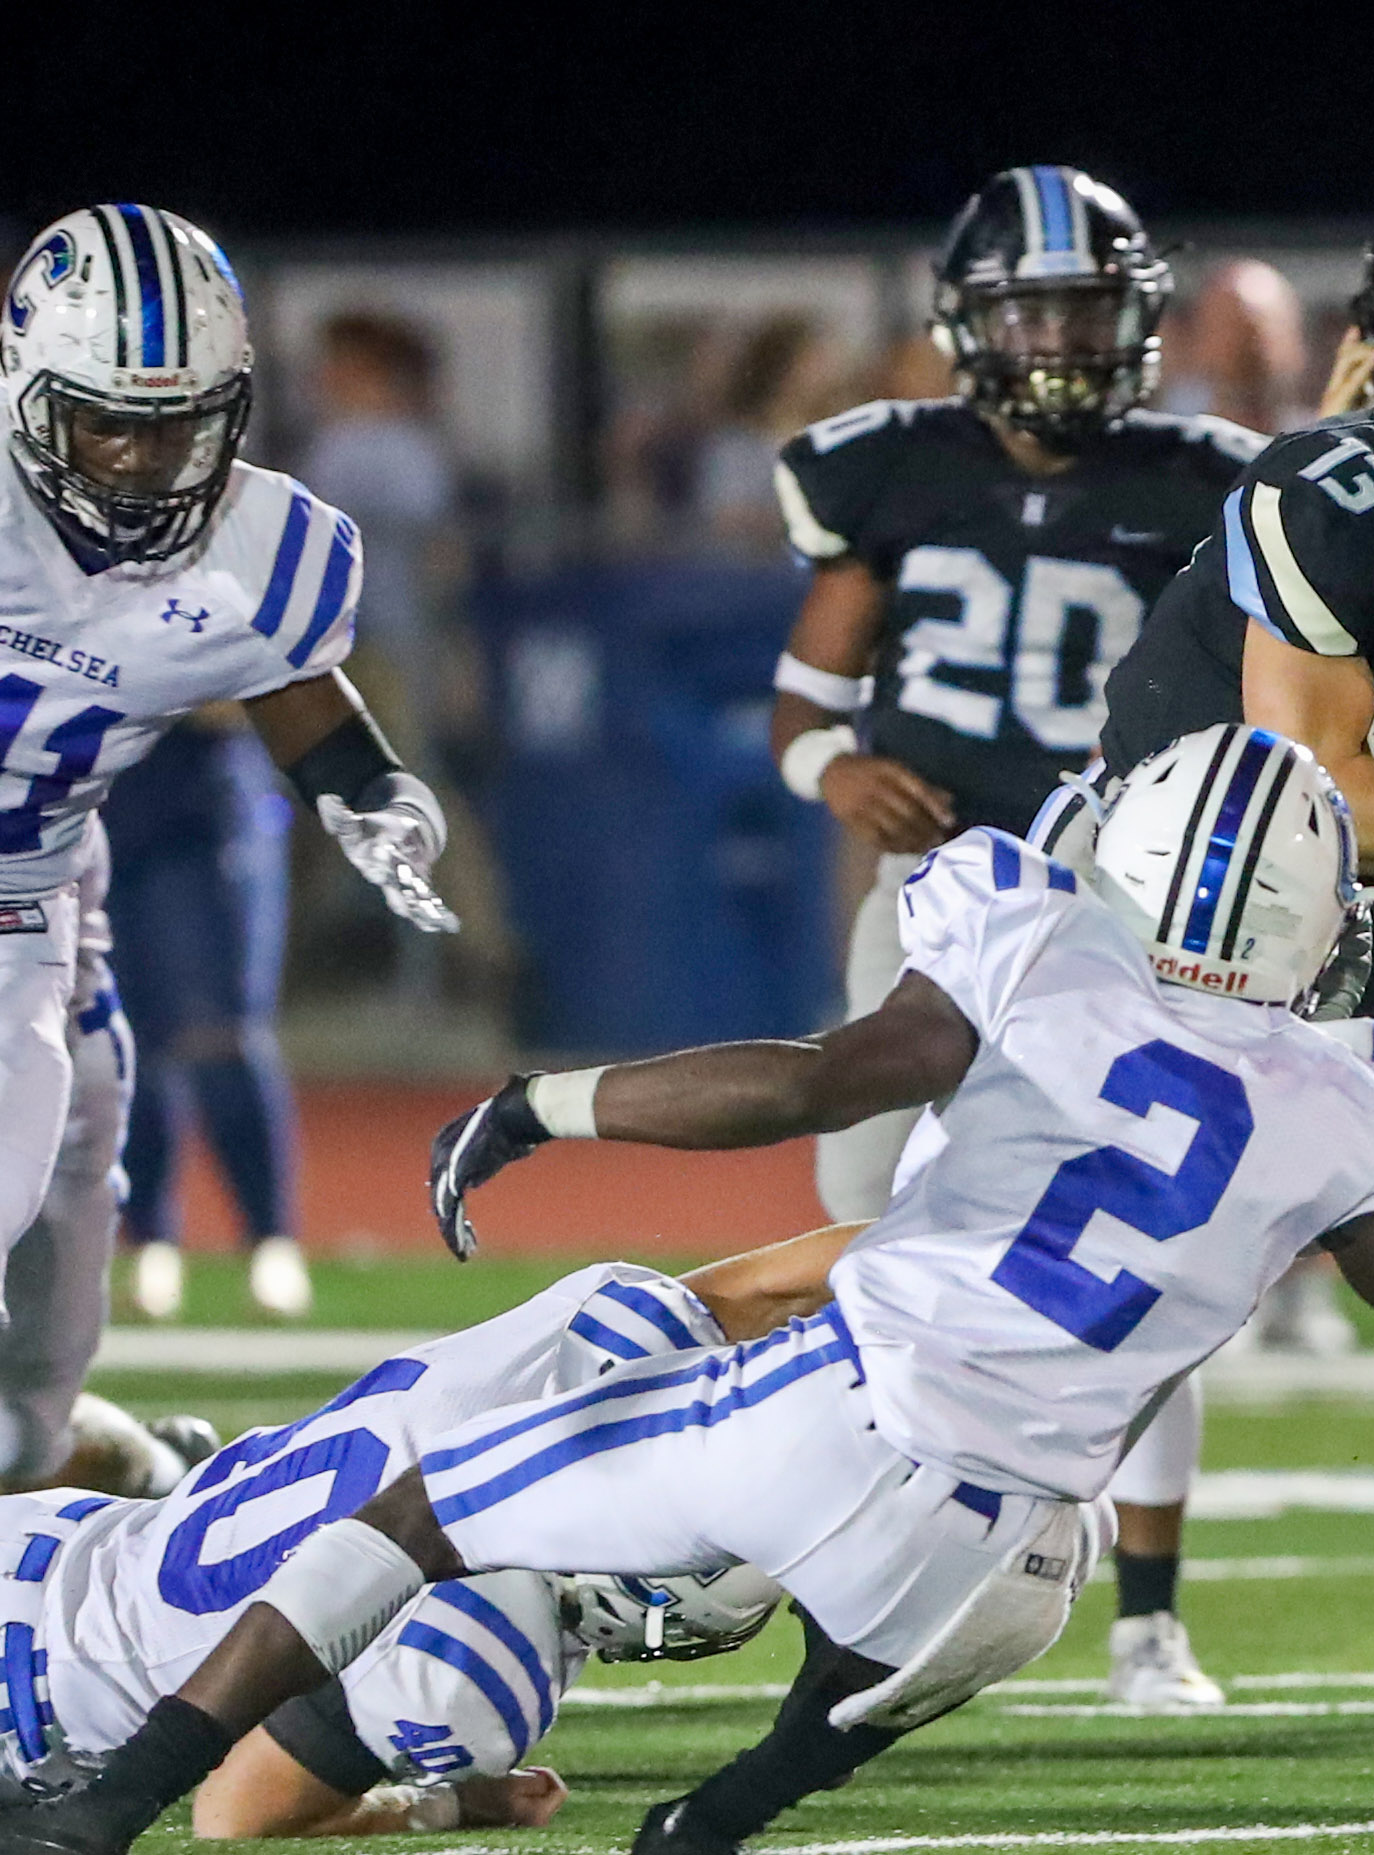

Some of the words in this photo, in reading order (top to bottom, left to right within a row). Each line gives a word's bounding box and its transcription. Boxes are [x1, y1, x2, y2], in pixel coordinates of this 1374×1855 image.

[0, 624, 121, 688] CHELSEA
[897, 543, 1146, 752] 20
[1240, 937, 1256, 960] 2
[989, 1037, 1256, 1353] 2
[386, 1718, 476, 1774] 40
